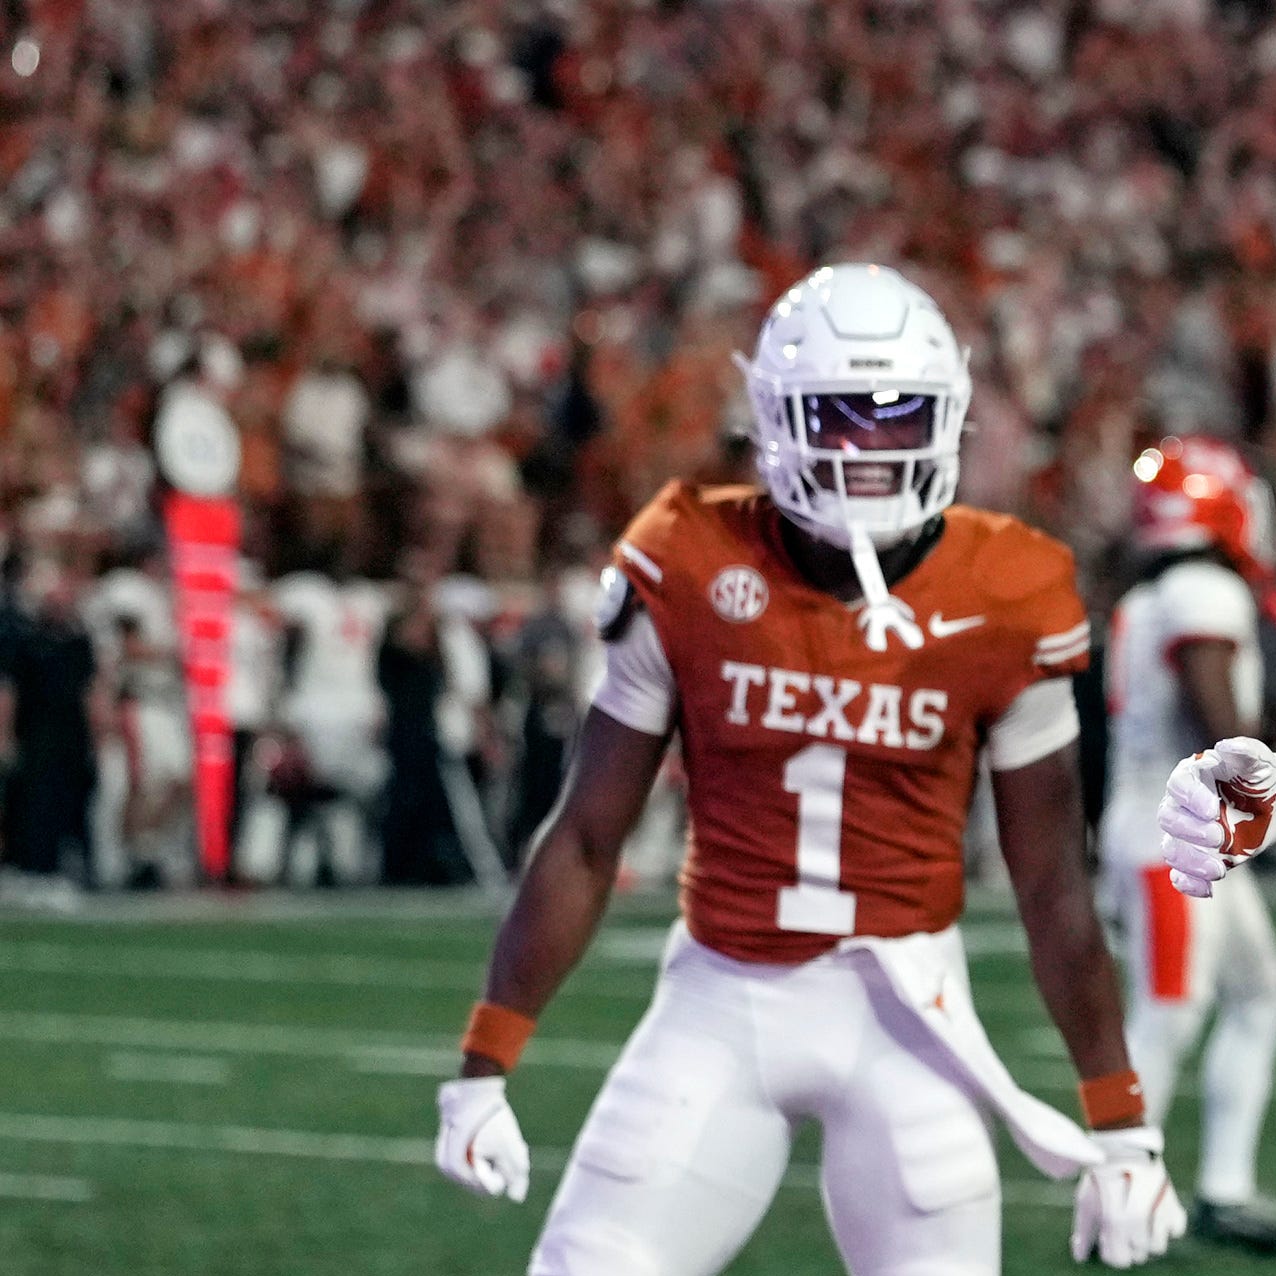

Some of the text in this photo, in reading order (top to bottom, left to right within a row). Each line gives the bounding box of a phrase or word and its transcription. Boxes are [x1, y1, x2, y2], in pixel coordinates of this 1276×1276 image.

[710, 568, 767, 621] SEC
[721, 661, 948, 751] TEXAS
[777, 744, 857, 936] 1
